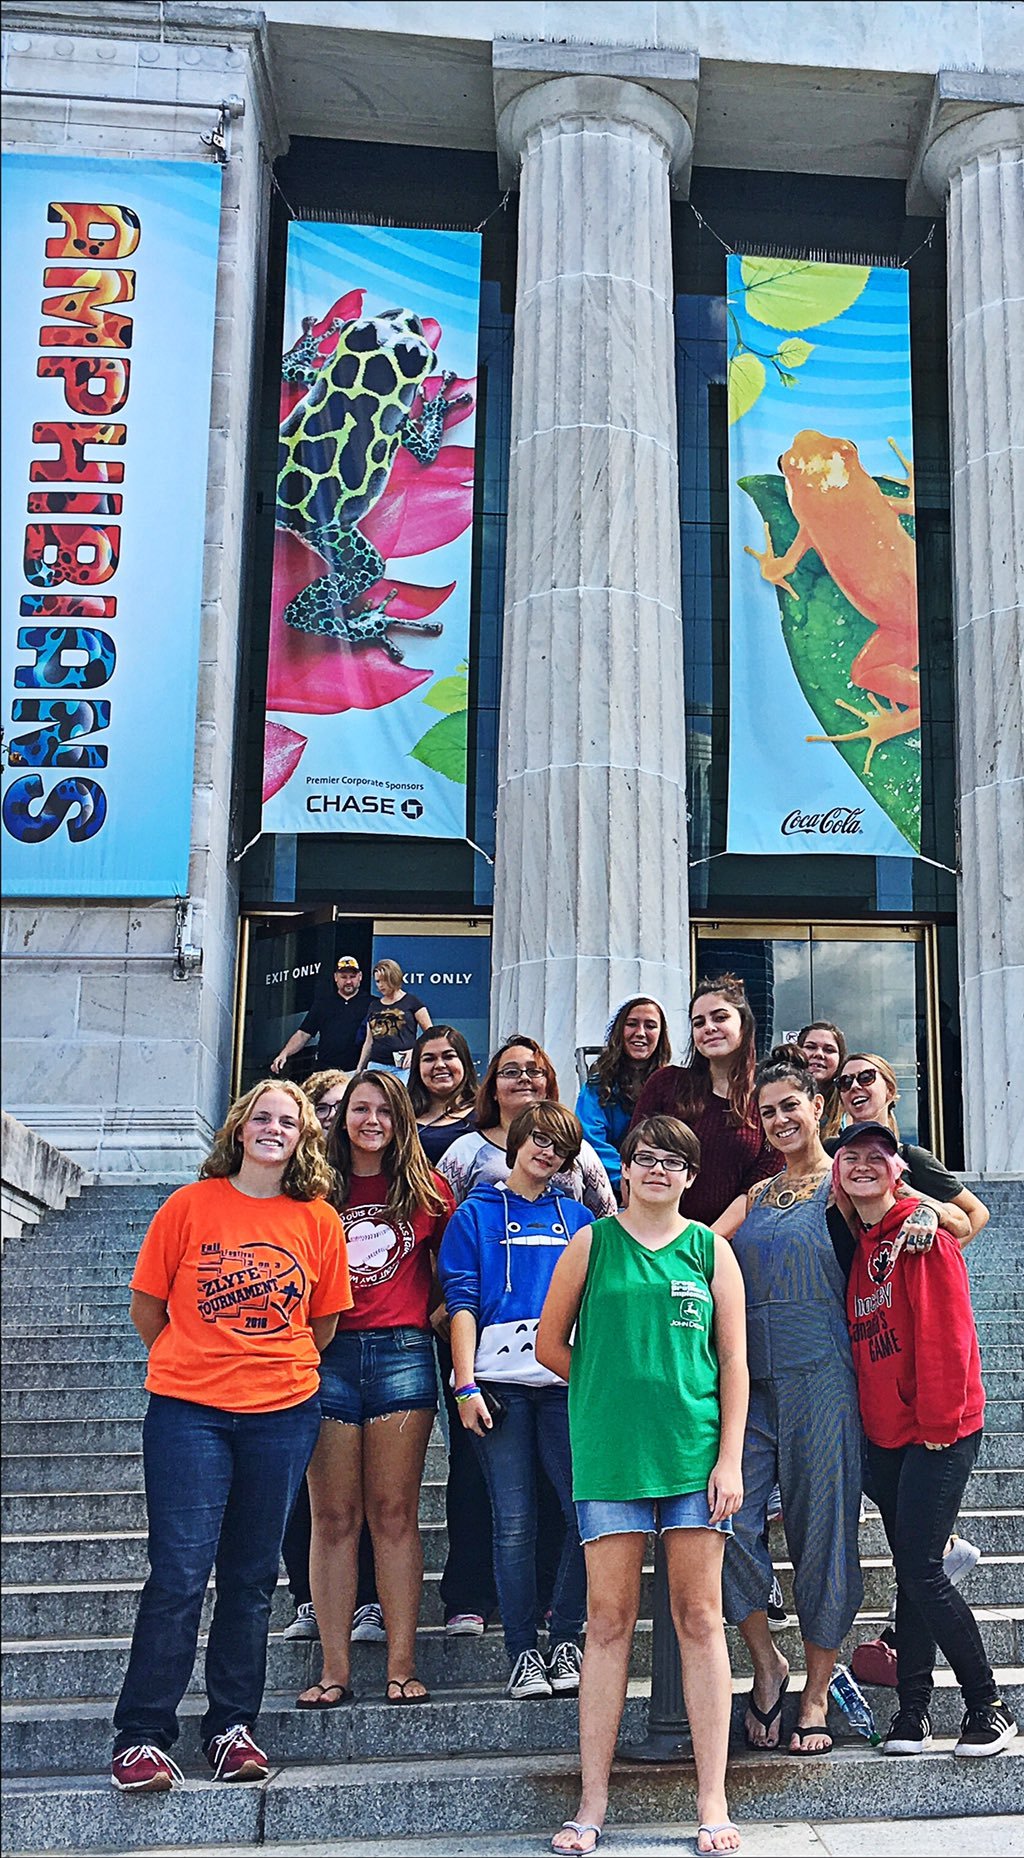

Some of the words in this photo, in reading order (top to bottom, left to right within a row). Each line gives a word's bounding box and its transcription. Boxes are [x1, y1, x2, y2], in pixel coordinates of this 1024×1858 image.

[2, 201, 142, 844] AMPHIBIANS
[306, 776, 340, 784] Premier
[341, 776, 384, 788] Corporate
[385, 781, 425, 791] Sponsors
[306, 795, 396, 815] CHASE
[265, 970, 290, 985] EXIT
[292, 962, 321, 979] ONLY
[402, 973, 425, 984] XIT
[430, 973, 473, 984] ONLY
[202, 1267, 261, 1297] ZLYFE
[868, 1328, 902, 1363] GAME
